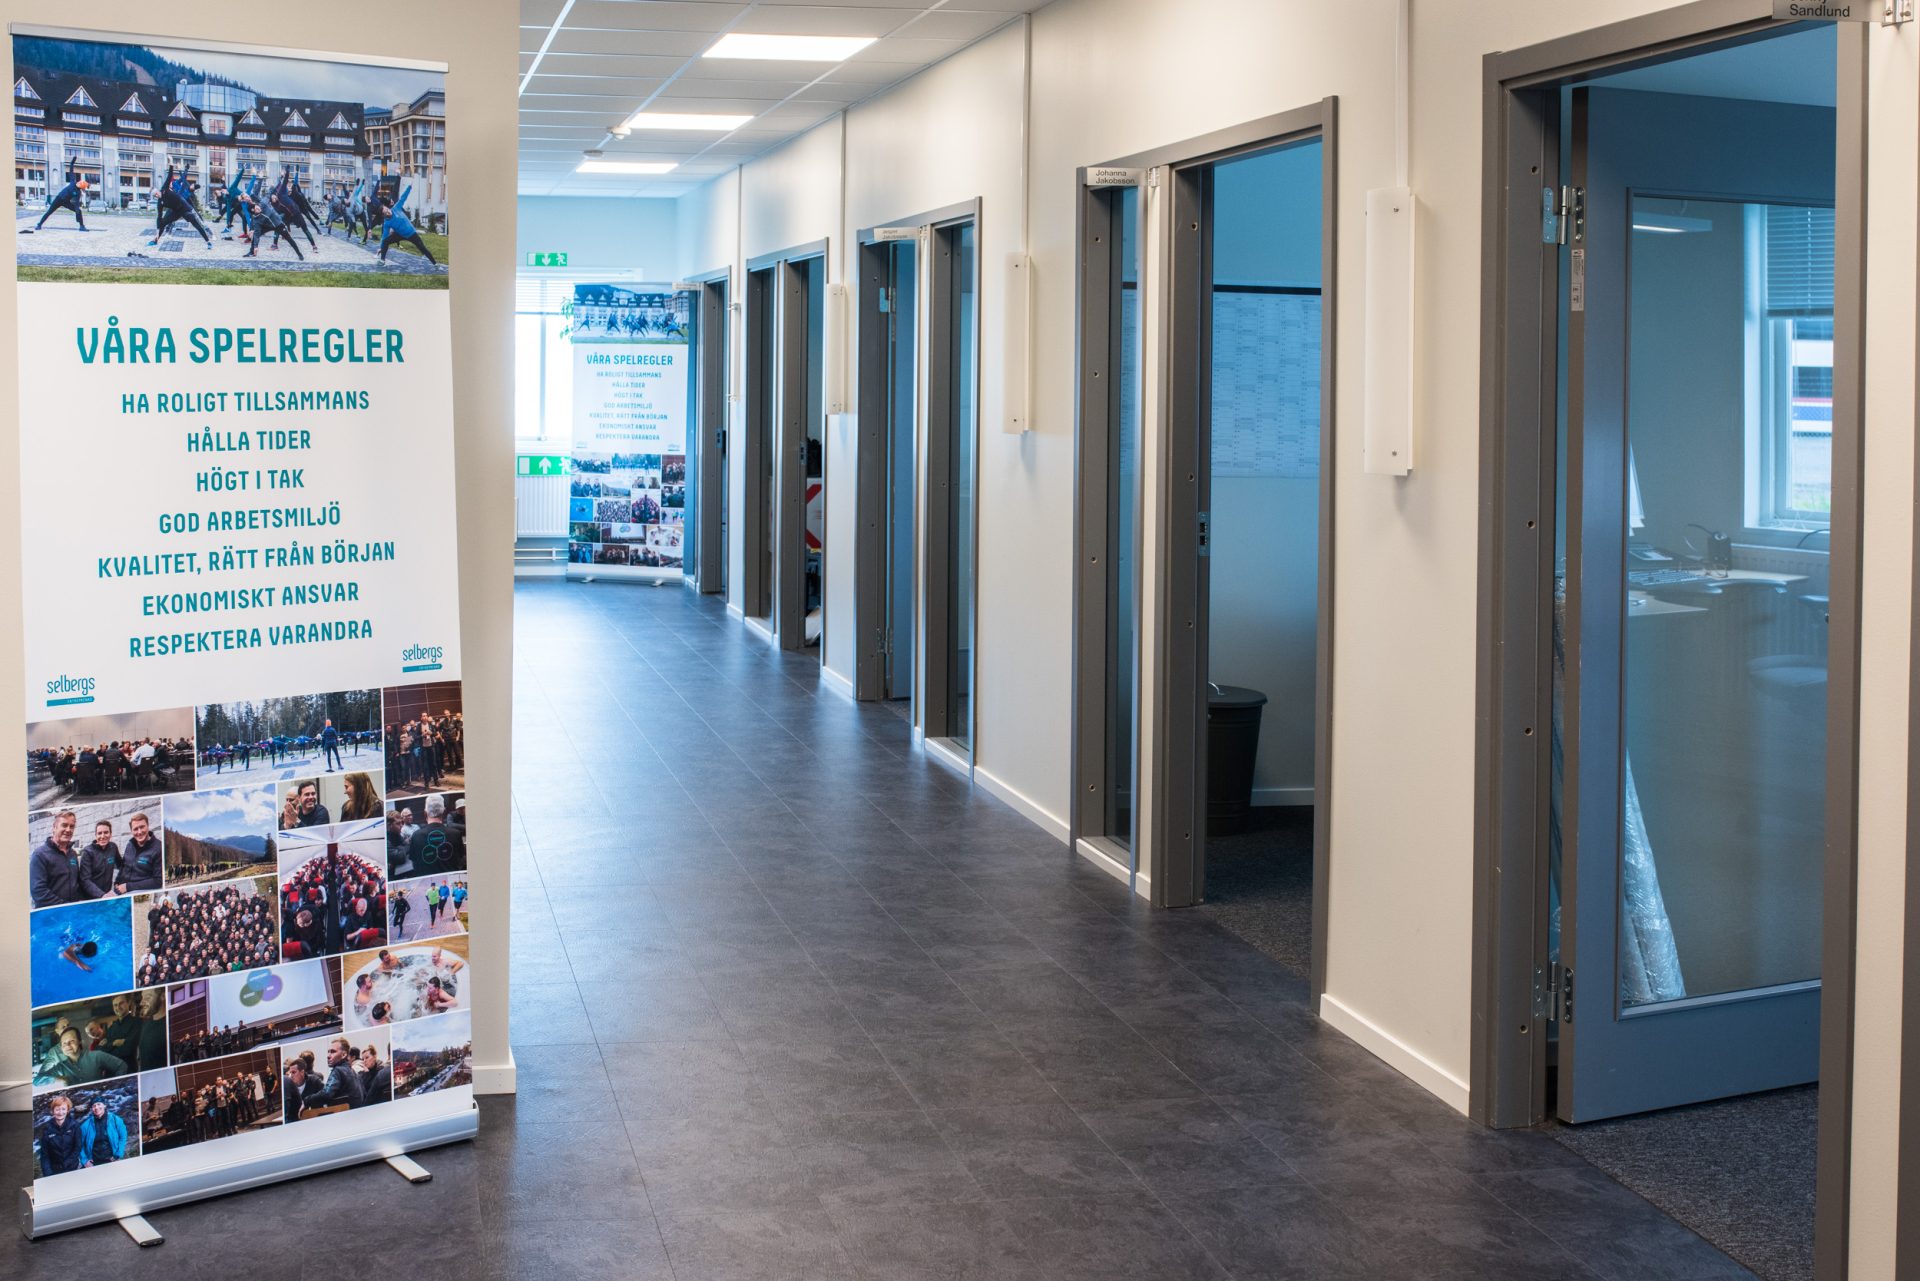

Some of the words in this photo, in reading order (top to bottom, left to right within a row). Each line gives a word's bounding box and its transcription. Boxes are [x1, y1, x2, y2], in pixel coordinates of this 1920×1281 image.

[1789, 3, 1851, 18] Sandlund
[1095, 169, 1127, 177] Johanna
[75, 315, 177, 364] VÅRA
[188, 327, 405, 364] SPELREGLER
[586, 352, 611, 365] VÅRA
[613, 354, 673, 366] SPELREGLER
[121, 392, 150, 415] HA
[157, 391, 228, 413] ROLIGT
[233, 390, 370, 412] TILLSAMMANS
[187, 427, 250, 452] HÅLLA
[256, 430, 311, 451] TIDER
[195, 467, 249, 492] HÖGT
[255, 470, 261, 490] I
[267, 469, 305, 489] TAK
[158, 512, 200, 535] GOD
[206, 501, 341, 532] ARBETSMILJÖ
[97, 551, 202, 578] KVALITET,
[208, 545, 259, 572] RÄTT
[264, 541, 315, 569] FRÅN
[320, 540, 396, 566] BÖRJAN
[142, 586, 276, 617] EKONOMISKT
[281, 581, 360, 607] ANSVAR
[129, 627, 262, 658] RESPEKTERA
[268, 619, 373, 647] VARANDRA
[402, 643, 443, 663] selbergs
[46, 674, 96, 696] selbergs
